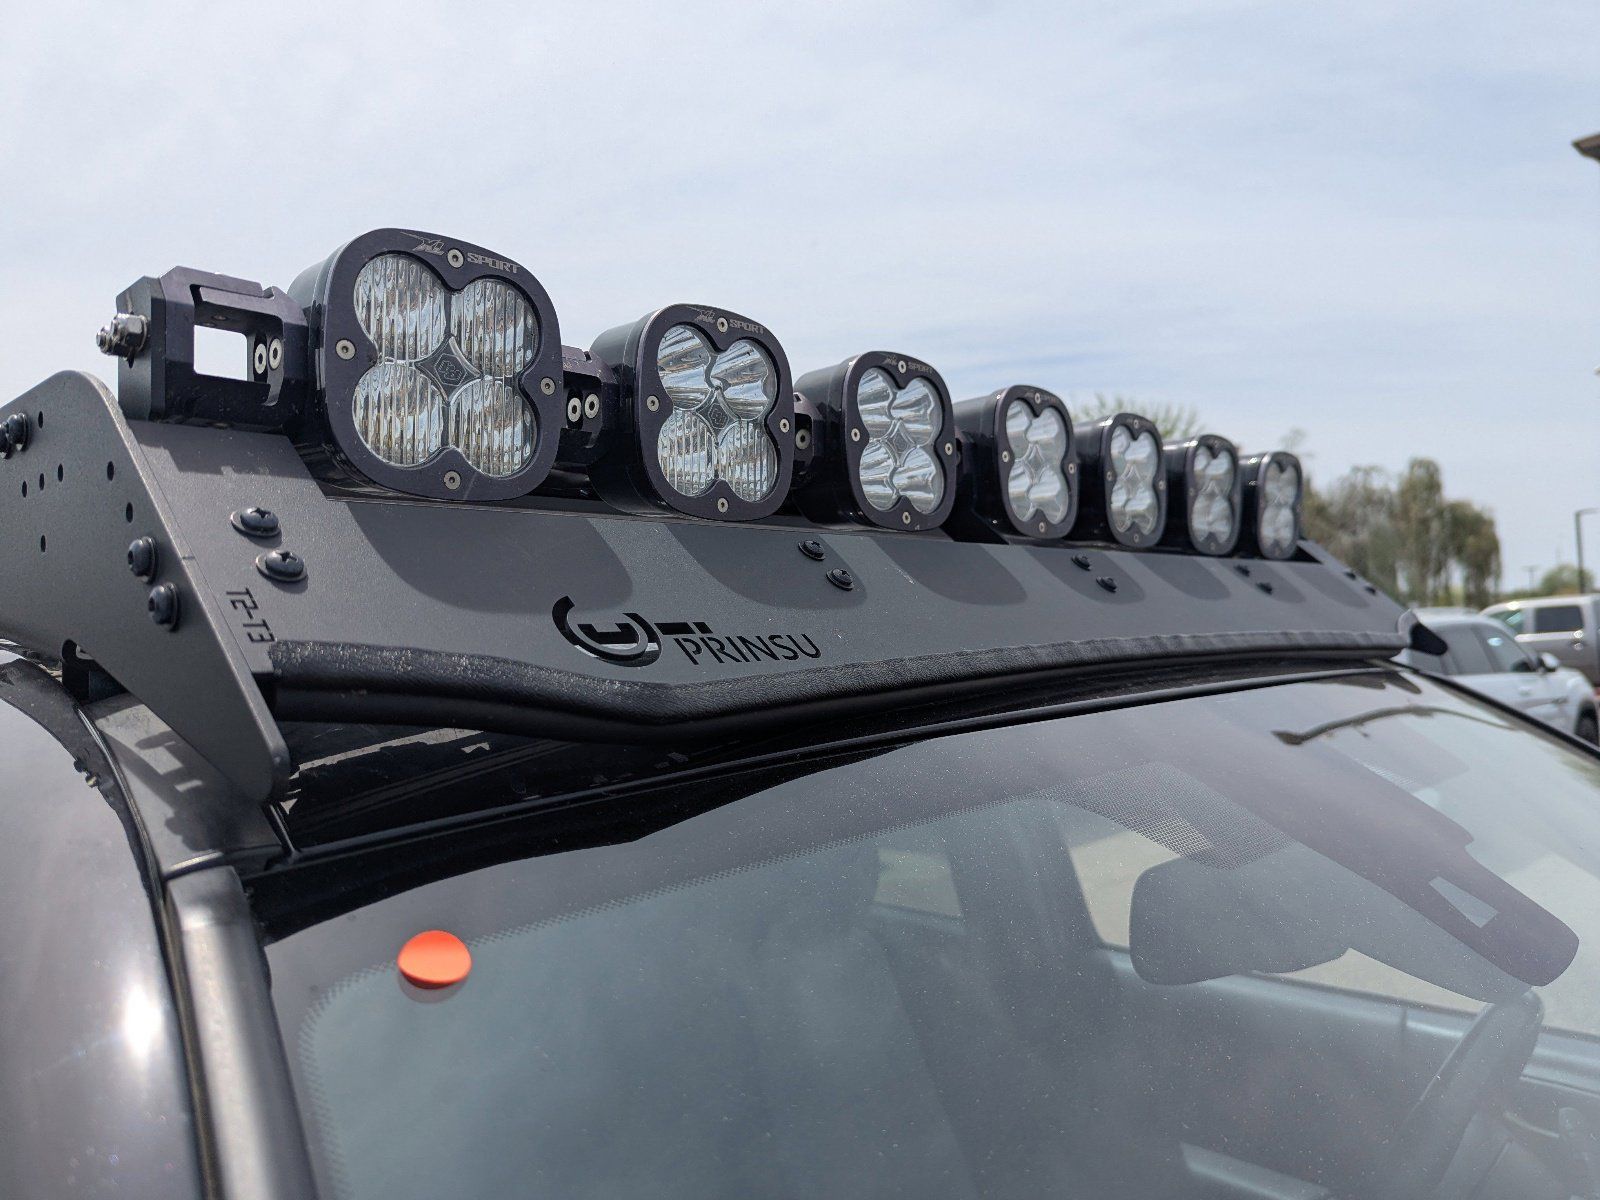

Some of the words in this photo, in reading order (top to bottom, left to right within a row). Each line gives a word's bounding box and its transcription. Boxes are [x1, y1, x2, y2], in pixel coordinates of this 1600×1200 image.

[467, 252, 520, 274] SPORT
[729, 319, 764, 335] SPORT
[226, 587, 275, 642] T2-T3
[674, 633, 822, 665] PRINSU
